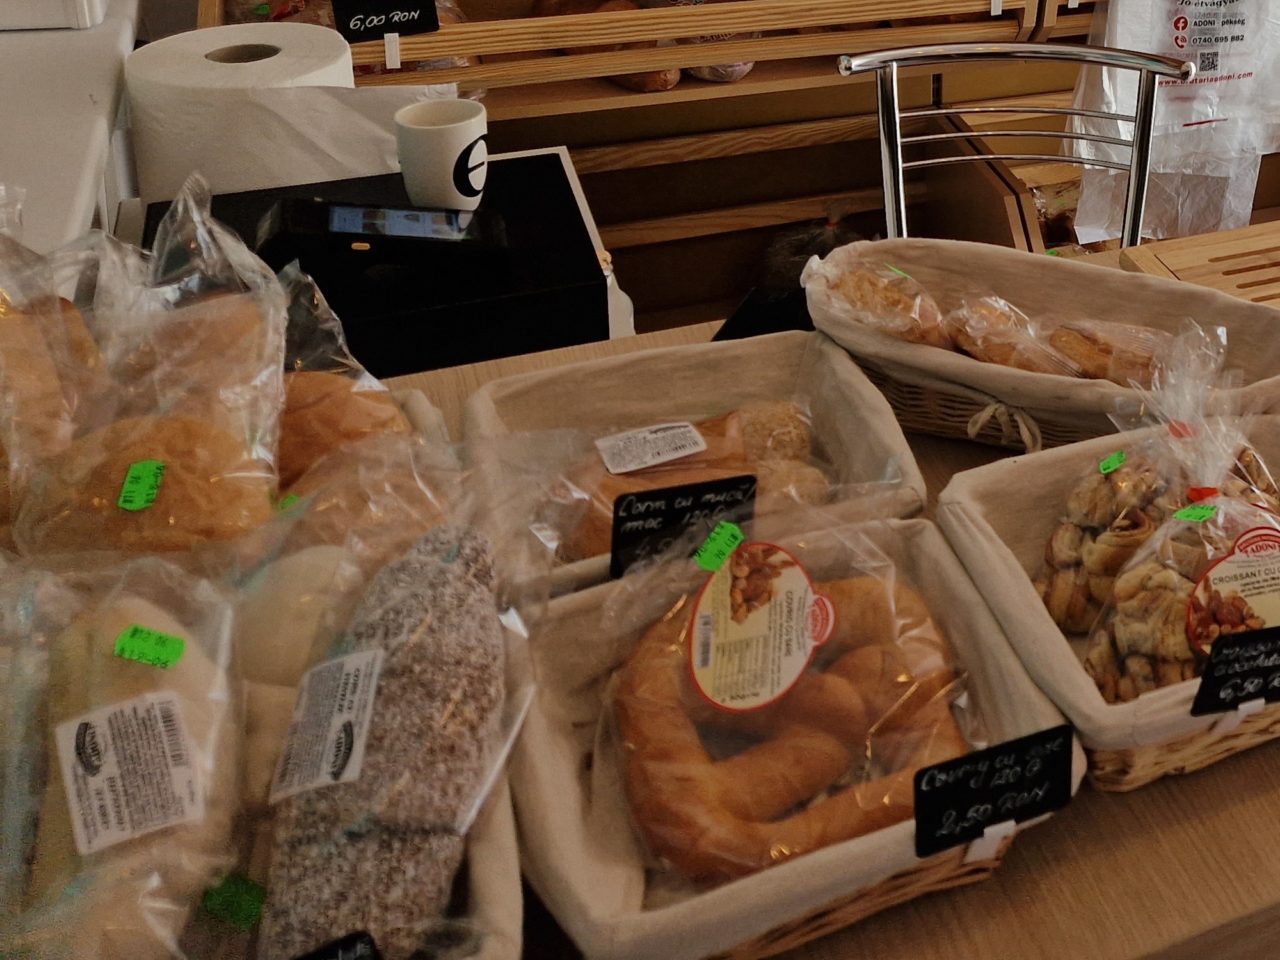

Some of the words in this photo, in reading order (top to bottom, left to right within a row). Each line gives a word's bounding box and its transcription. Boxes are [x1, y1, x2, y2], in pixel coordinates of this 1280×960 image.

[349, 15, 386, 31] 6,00
[389, 10, 420, 23] RON
[1193, 19, 1216, 27] ADONI
[1192, 37, 1213, 45] 0740
[1249, 543, 1277, 554] ADONI
[1212, 571, 1262, 586] CROISSANT
[1263, 568, 1277, 577] CU
